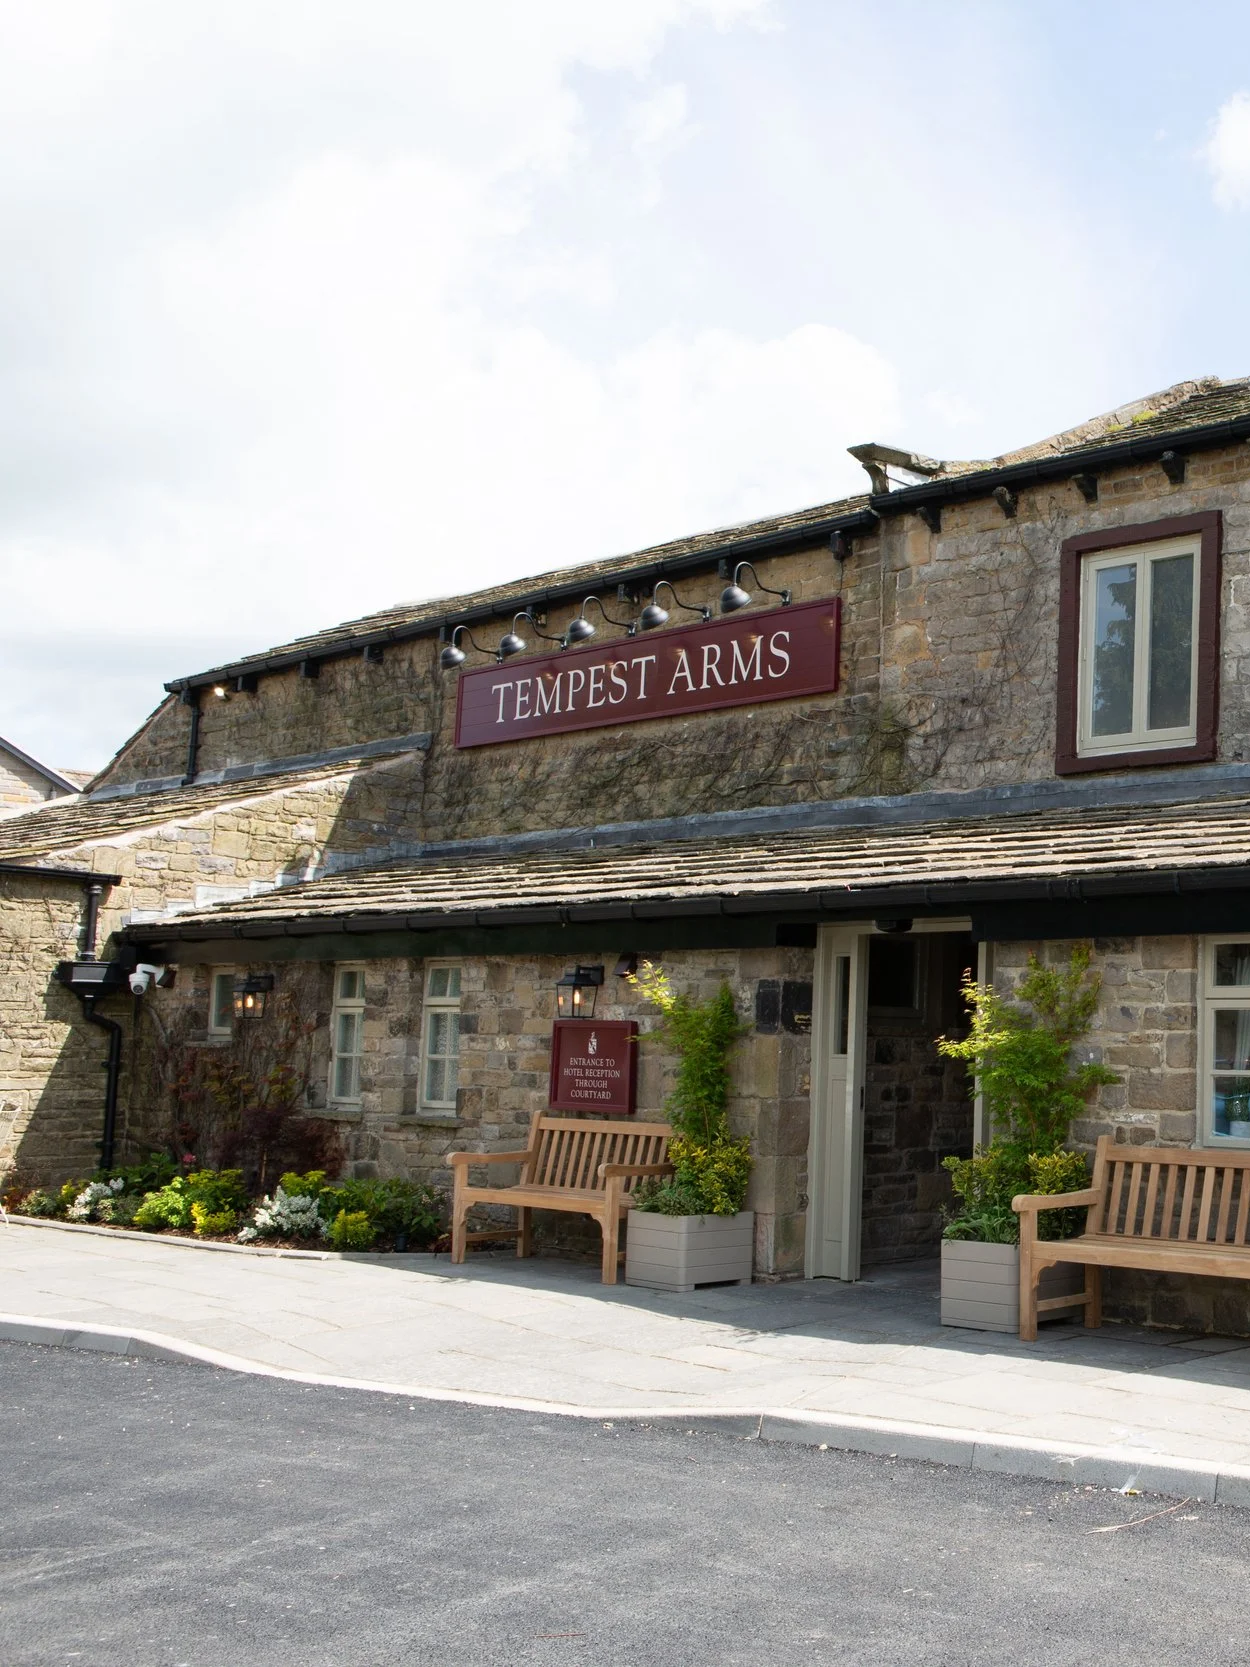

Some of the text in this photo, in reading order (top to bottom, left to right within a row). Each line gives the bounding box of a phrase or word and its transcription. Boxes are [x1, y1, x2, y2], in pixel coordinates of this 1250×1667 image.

[491, 630, 791, 724] TEMPEST ARMS
[570, 1057, 615, 1067] ENTRANCE TO
[563, 1068, 621, 1078] HOTEL RECEPTION
[575, 1079, 608, 1089] THROUGH
[570, 1090, 611, 1099] COURTYARD
